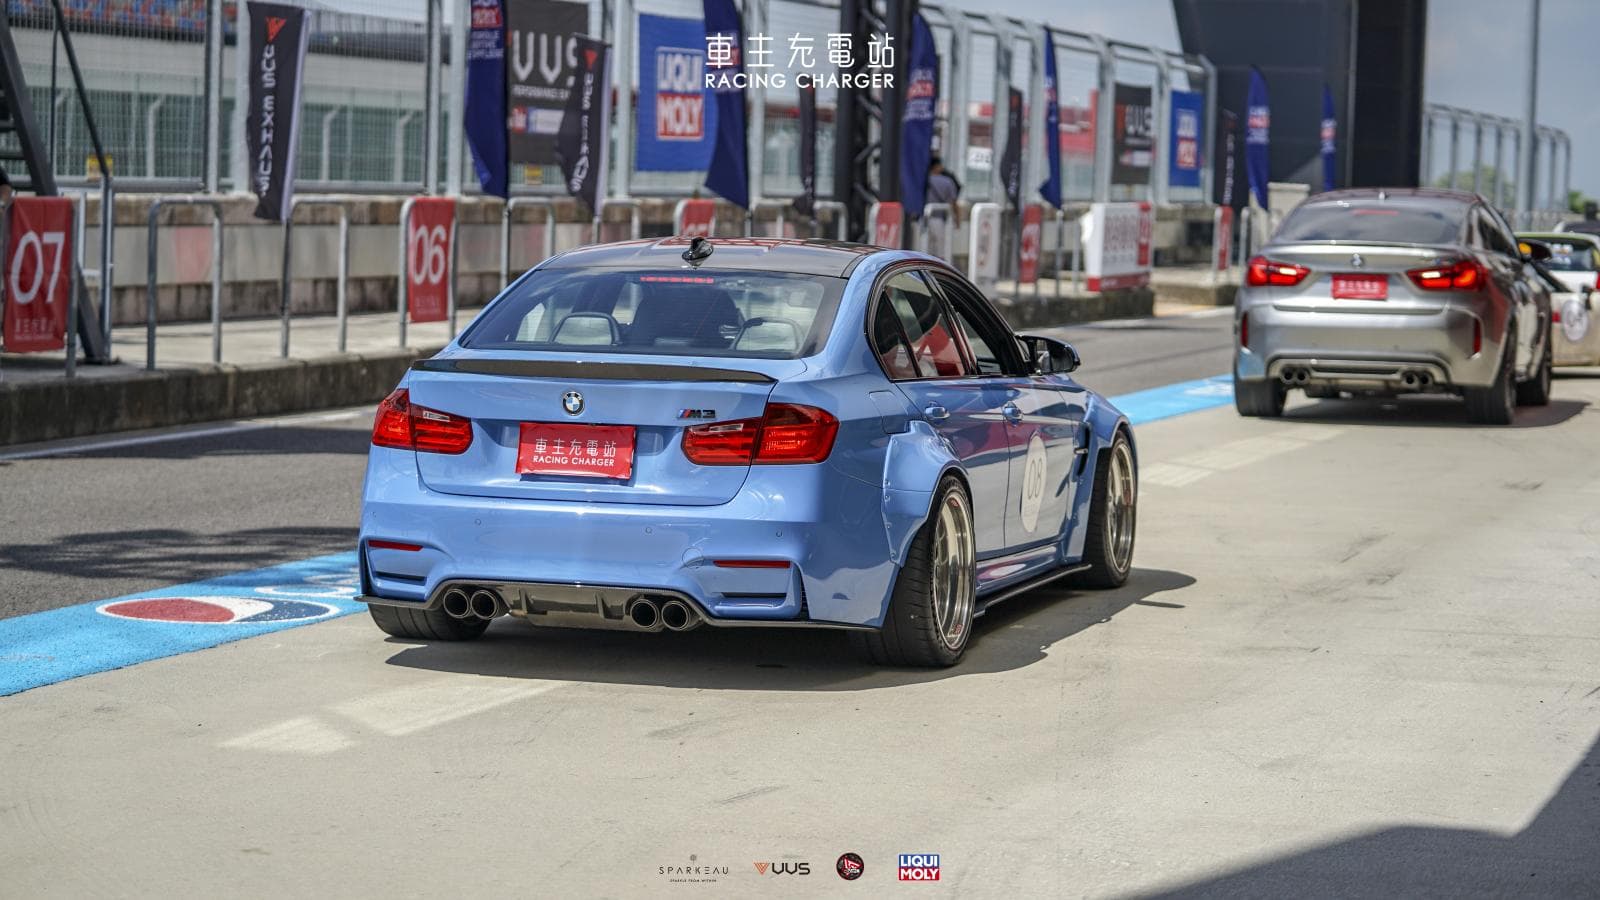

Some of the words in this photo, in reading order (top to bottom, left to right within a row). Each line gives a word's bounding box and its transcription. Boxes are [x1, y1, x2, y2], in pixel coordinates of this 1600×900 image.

[657, 54, 703, 93] LIQUI
[657, 96, 703, 134] MOLY
[11, 231, 65, 304] 07
[414, 224, 447, 285] 06
[533, 455, 568, 465] RACING
[571, 457, 615, 467] CHARGER
[534, 438, 617, 458] 車主充電站
